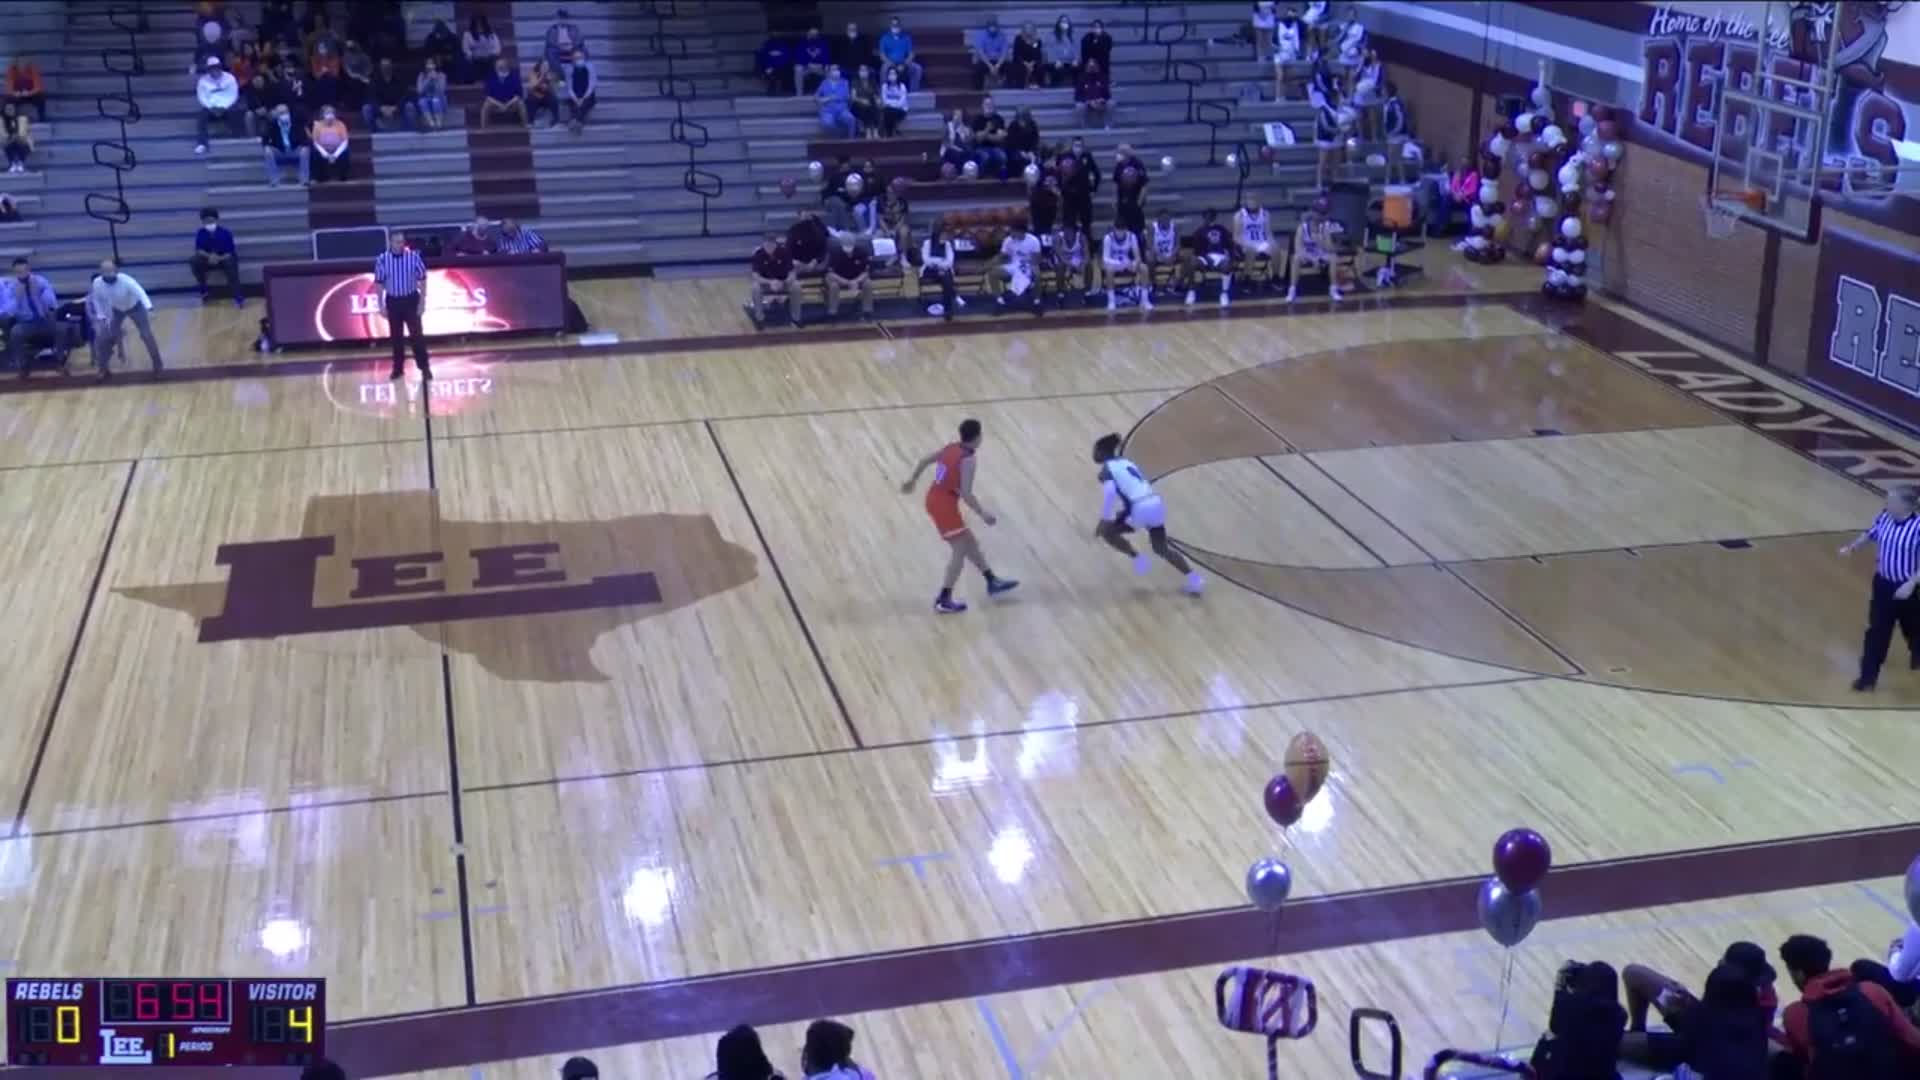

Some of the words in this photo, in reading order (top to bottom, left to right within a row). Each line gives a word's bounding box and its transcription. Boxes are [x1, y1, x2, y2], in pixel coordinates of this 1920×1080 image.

[1650, 6, 1700, 35] Home
[1703, 12, 1721, 41] of
[1726, 12, 1754, 38] the
[1613, 351, 1872, 438] LADY
